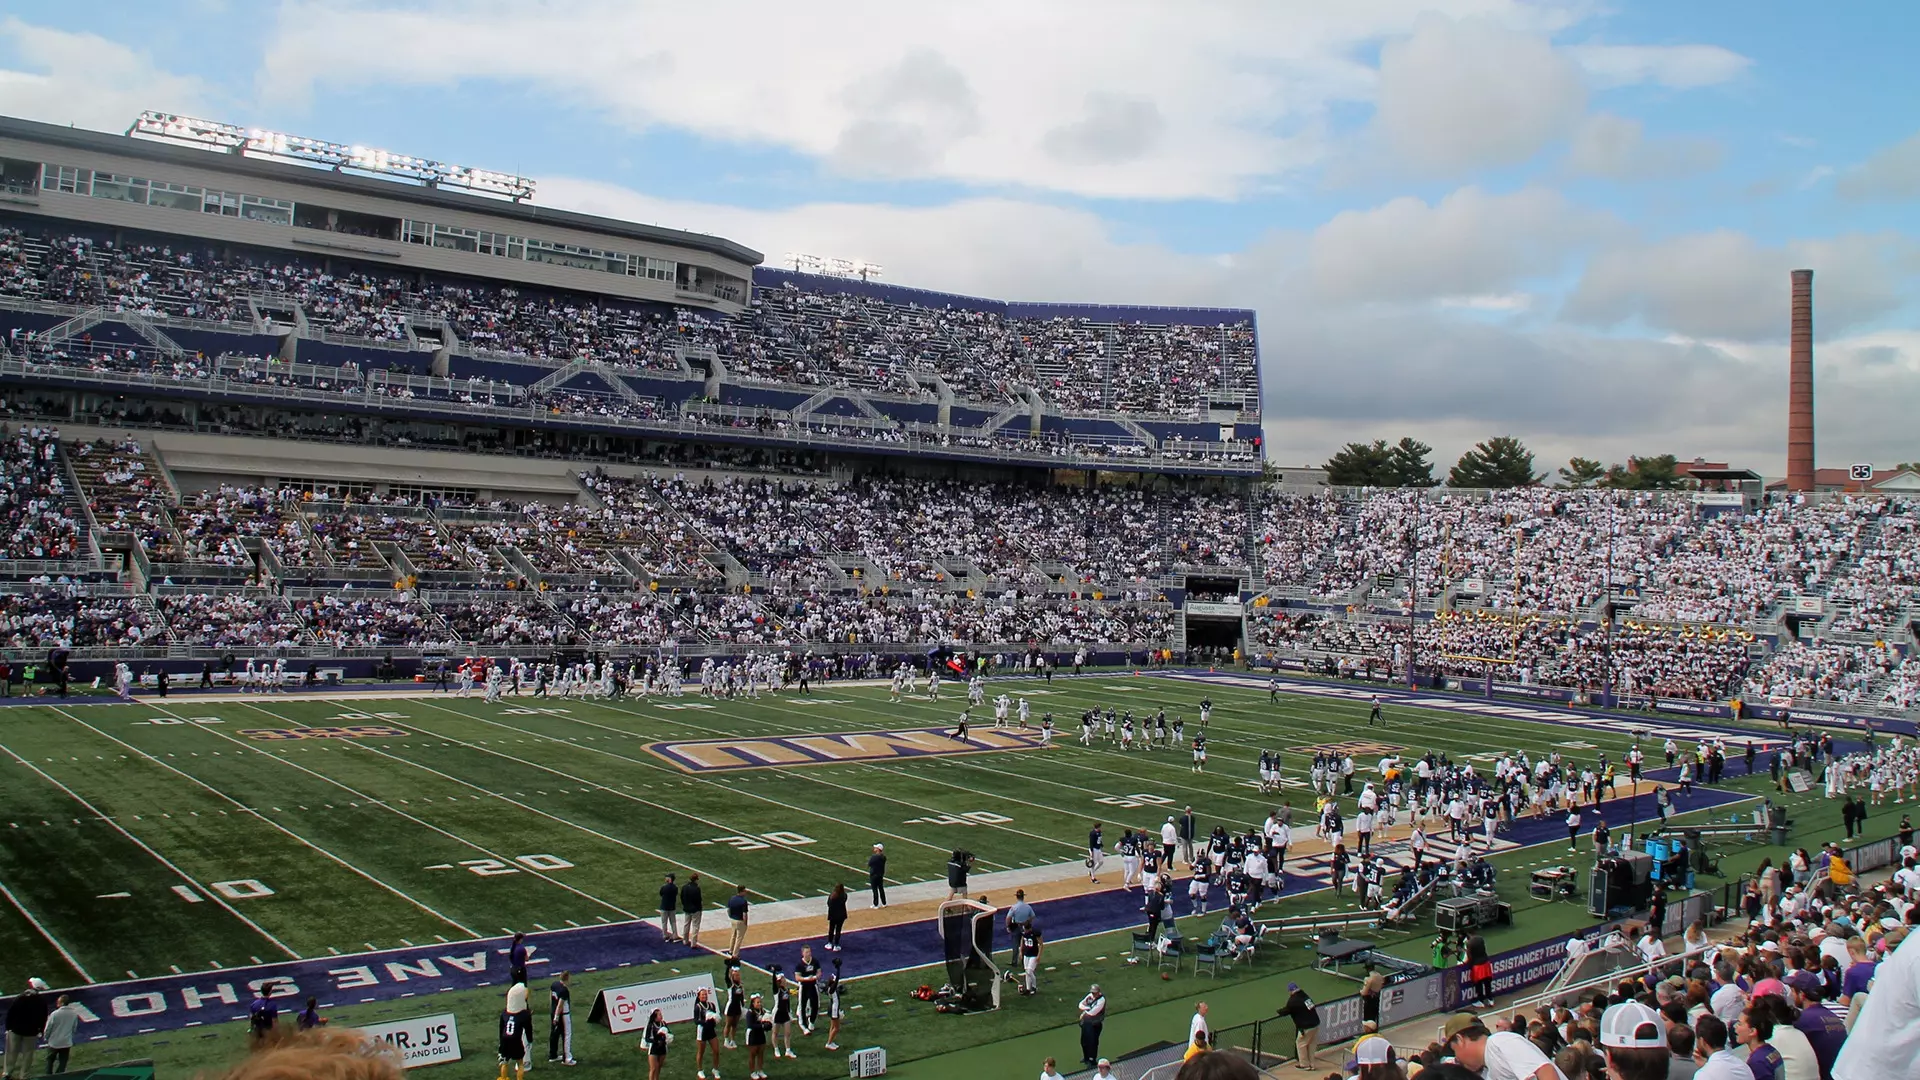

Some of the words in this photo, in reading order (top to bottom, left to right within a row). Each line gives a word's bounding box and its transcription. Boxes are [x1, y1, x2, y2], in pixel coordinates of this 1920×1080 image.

[1853, 466, 1869, 478] 25
[1123, 845, 1134, 855] 97
[458, 854, 575, 877] 20
[171, 879, 276, 903] 10
[1545, 941, 1566, 957] TEXT
[1490, 975, 1514, 993] SSUE
[1522, 960, 1561, 983] LOCATION
[421, 1024, 449, 1046] J'S
[411, 1049, 430, 1059] AND
[432, 1046, 451, 1056] DELI
[865, 1052, 880, 1060] FIGHT
[865, 1059, 880, 1068] FIGHT
